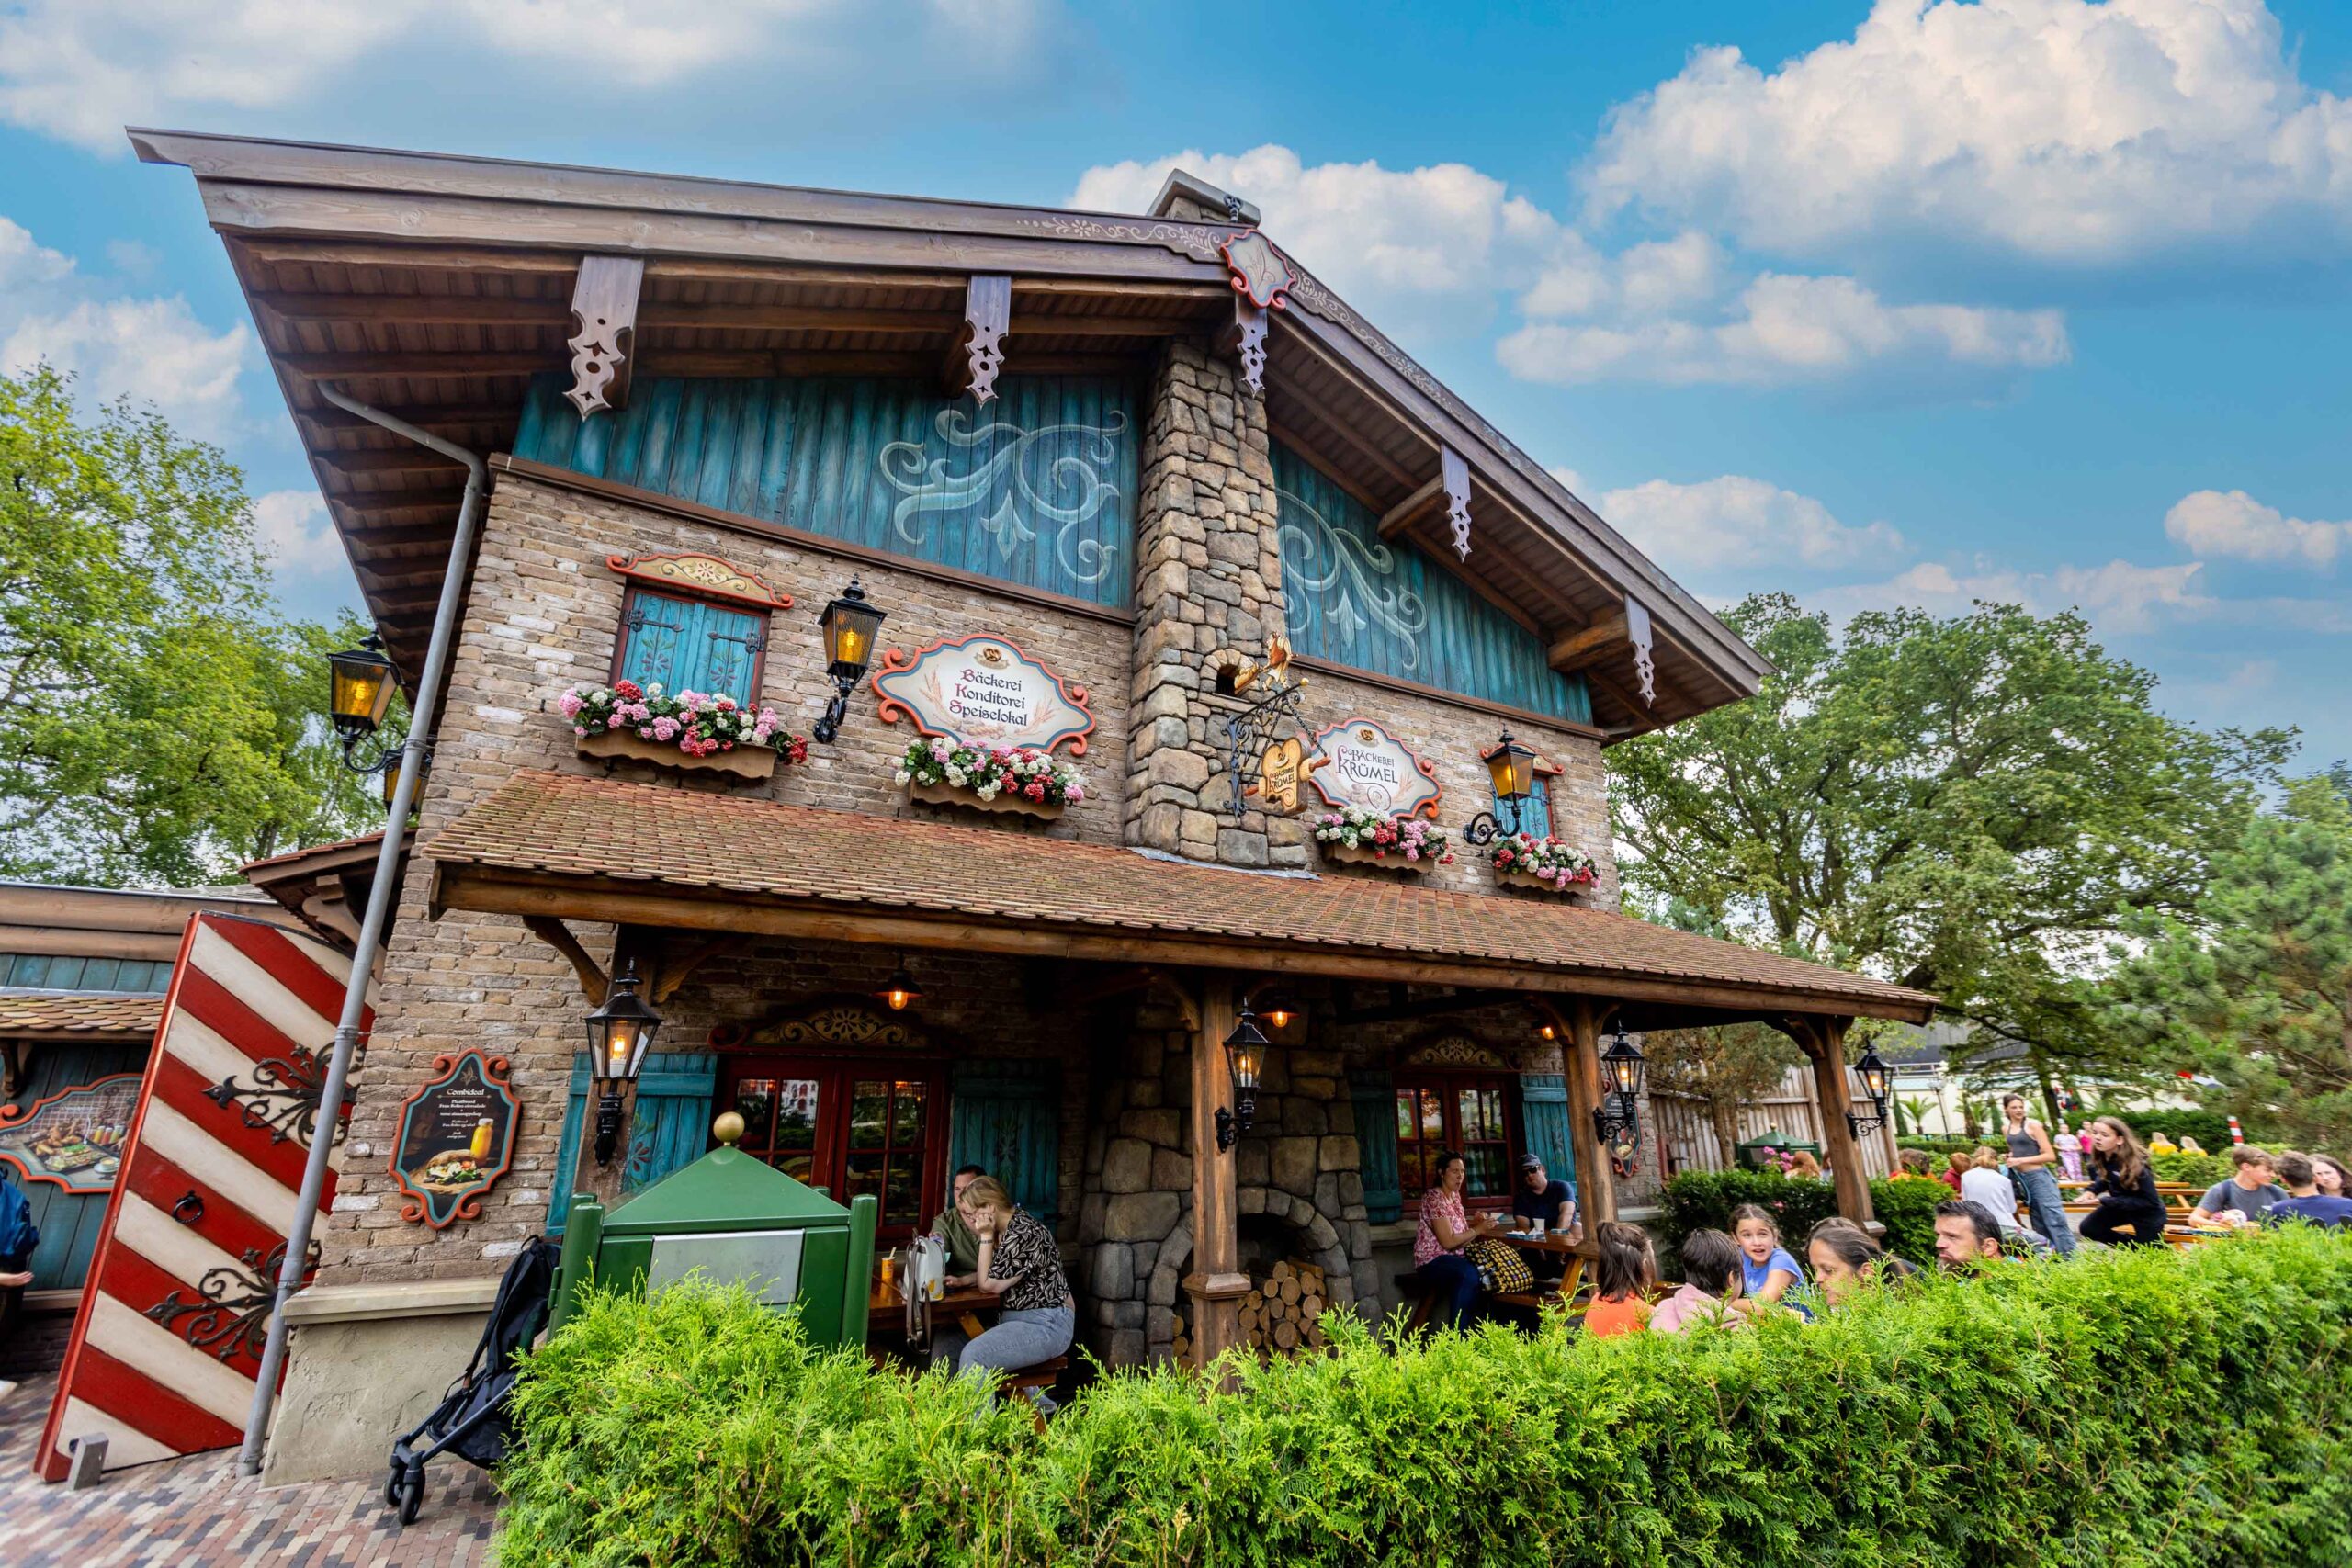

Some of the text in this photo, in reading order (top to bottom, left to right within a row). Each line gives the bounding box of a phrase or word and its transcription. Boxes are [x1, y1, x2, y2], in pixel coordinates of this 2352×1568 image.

[960, 669, 1022, 692] Bäckerei
[955, 683, 1025, 709] Konditorei
[949, 699, 1028, 726] Speiselokal
[1335, 745, 1398, 784] KRÜMEL
[1348, 749, 1395, 767] BÄCKEREI
